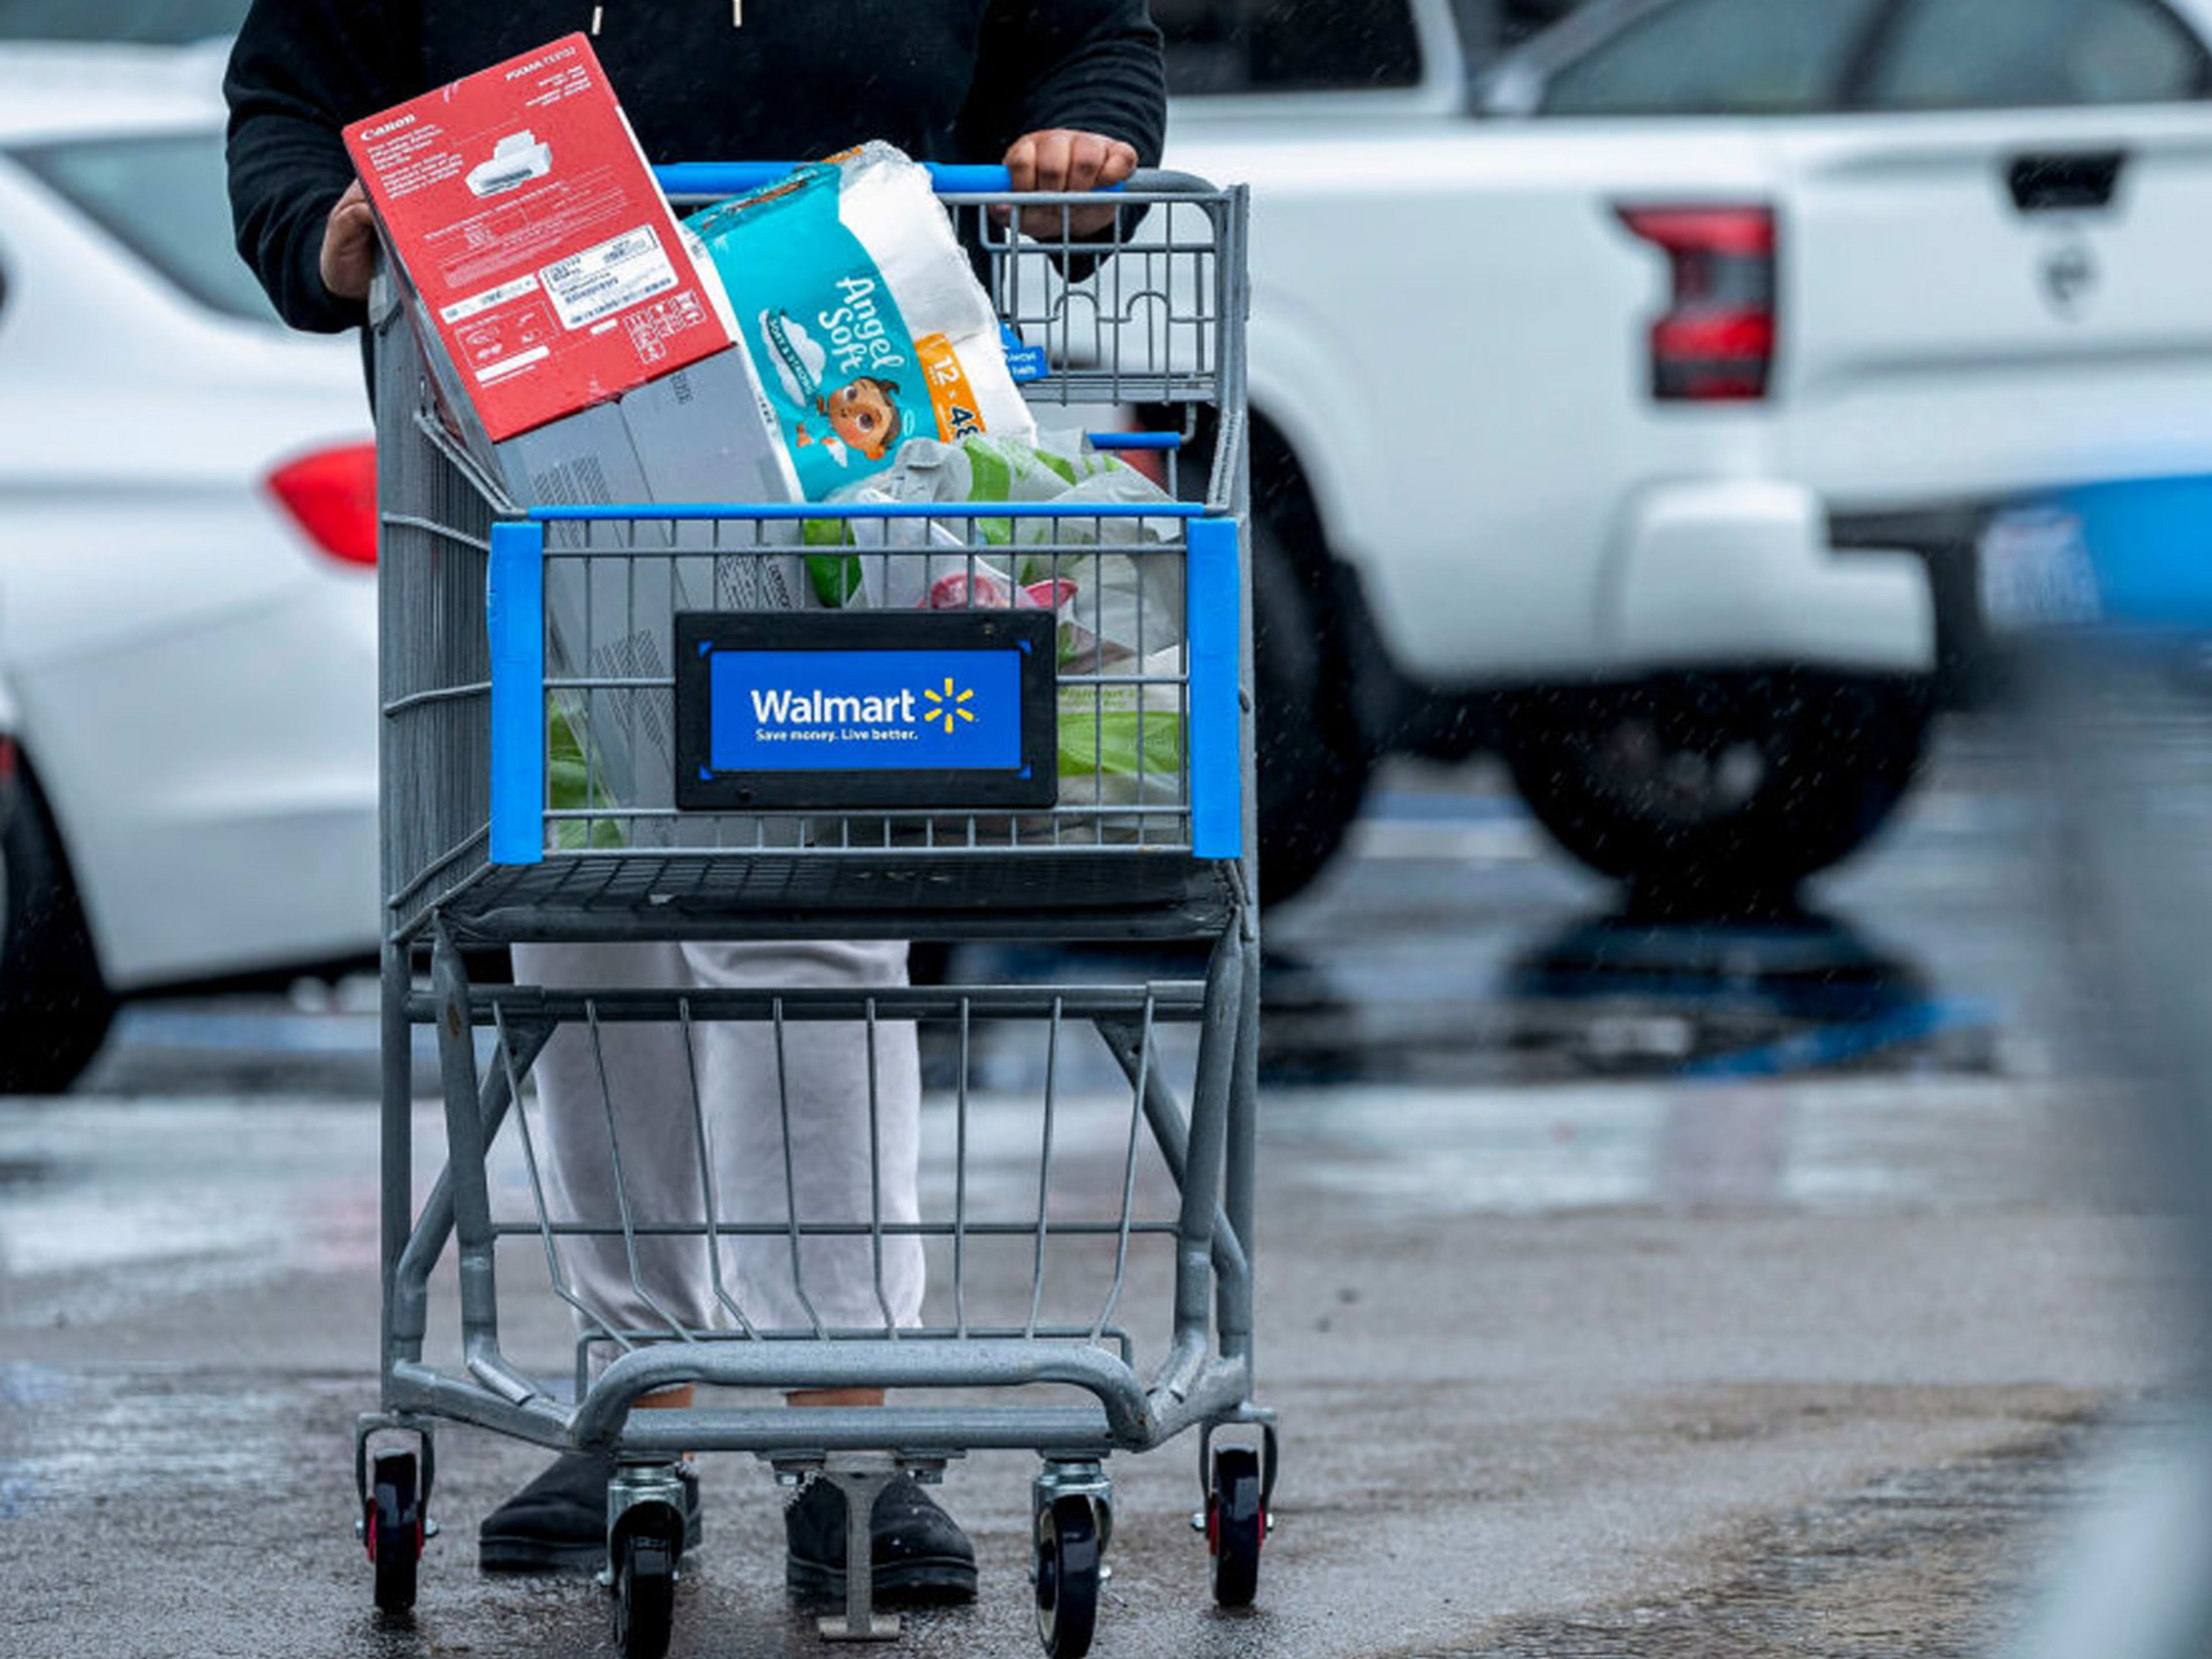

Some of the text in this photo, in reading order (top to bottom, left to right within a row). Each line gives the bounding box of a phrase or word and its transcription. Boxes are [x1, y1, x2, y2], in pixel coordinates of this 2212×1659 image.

[360, 113, 416, 141] Canon
[836, 276, 905, 370] Angel
[818, 307, 868, 374] Soft
[933, 356, 959, 386] 12
[751, 688, 916, 724] Walmart
[755, 728, 918, 743] Save money. Live better.
